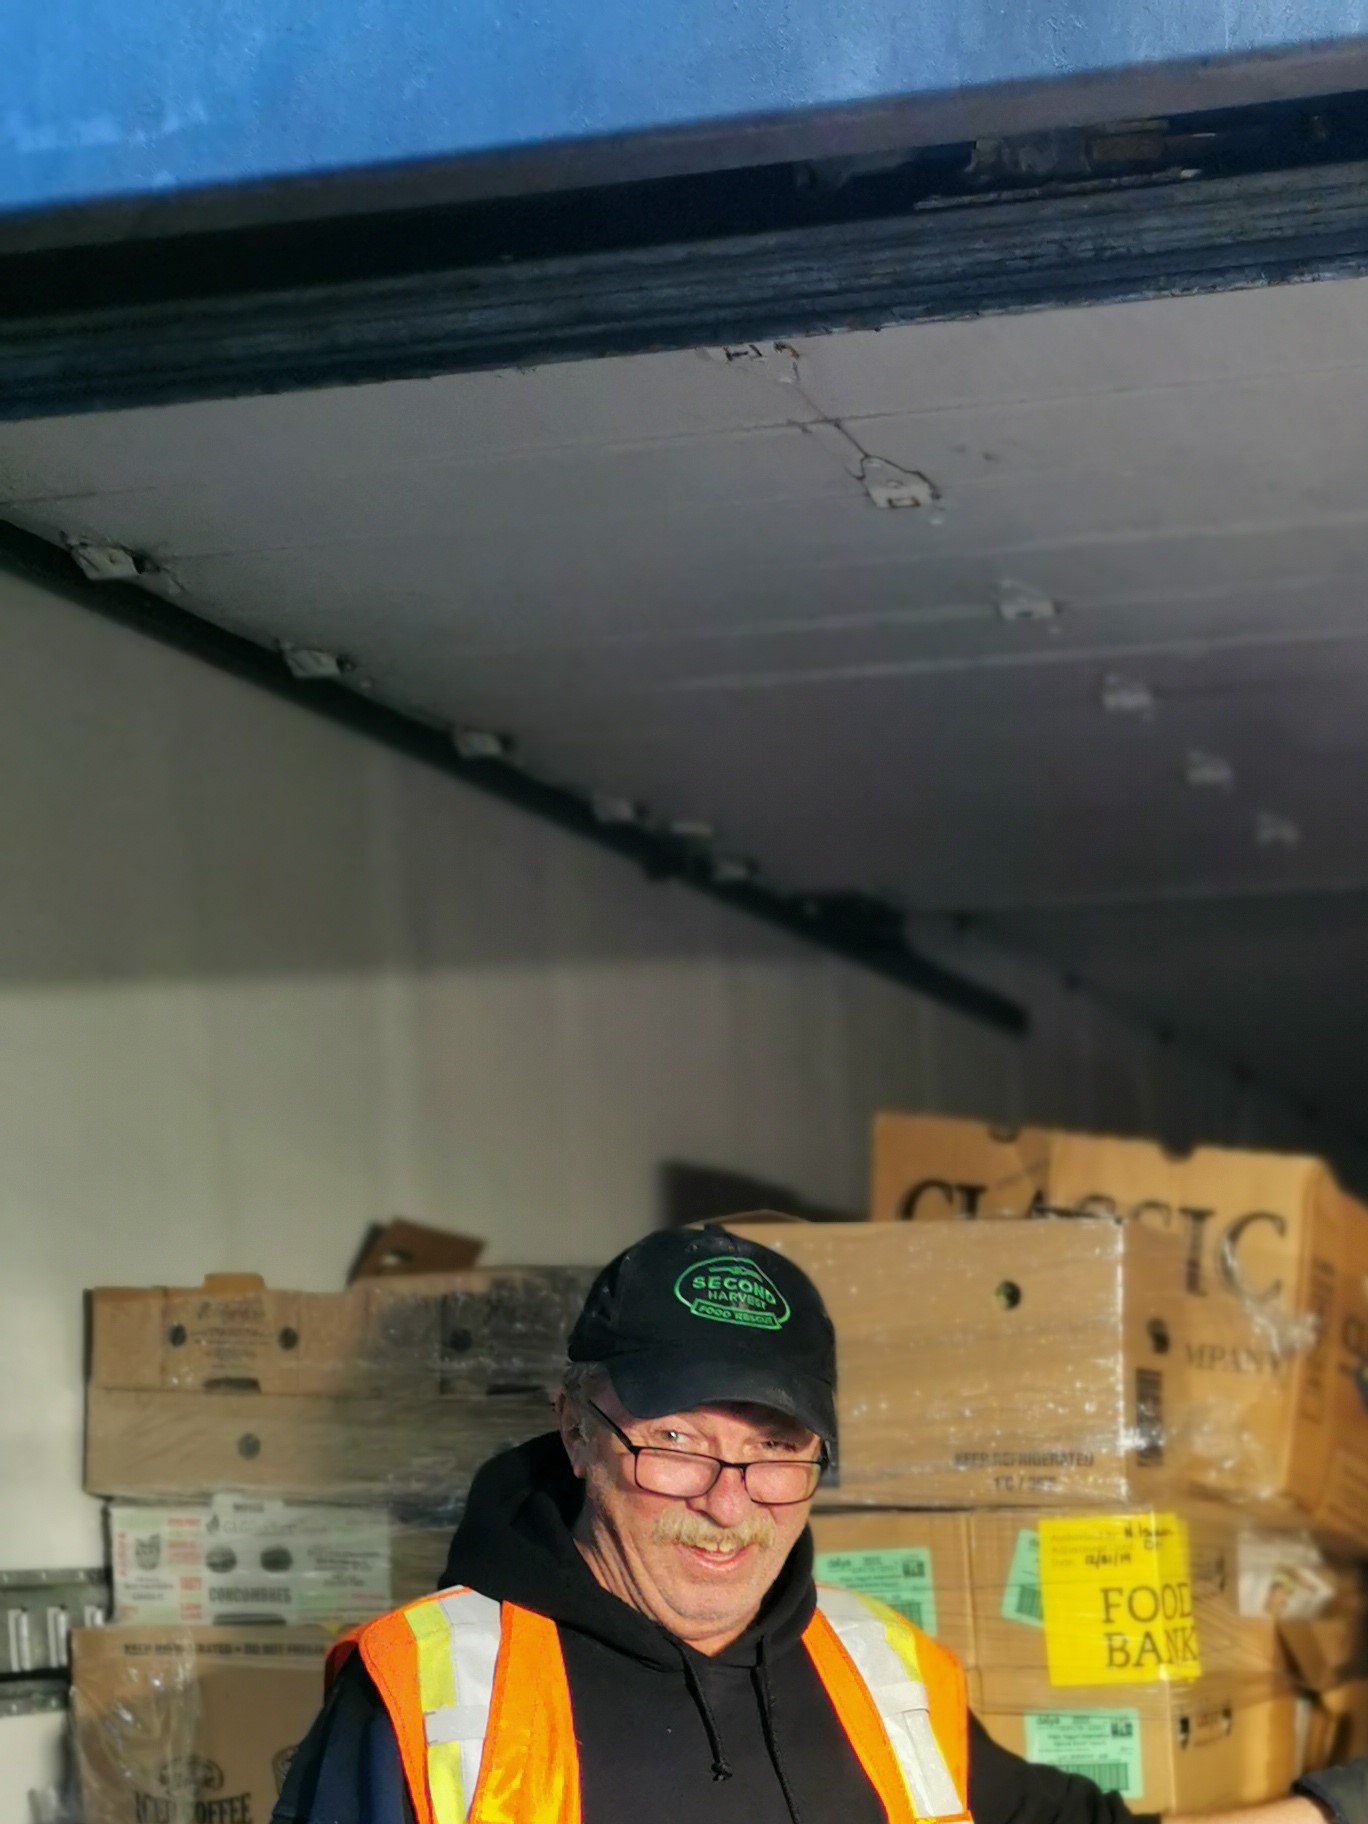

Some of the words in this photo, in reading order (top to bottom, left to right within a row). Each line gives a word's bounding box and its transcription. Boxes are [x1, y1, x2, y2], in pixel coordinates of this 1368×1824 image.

[692, 1275, 776, 1305] SECOND
[708, 1290, 766, 1311] HARVEST
[699, 1305, 731, 1319] FOOD
[1099, 1581, 1193, 1625] FOOD
[1103, 1626, 1199, 1669] BANK
